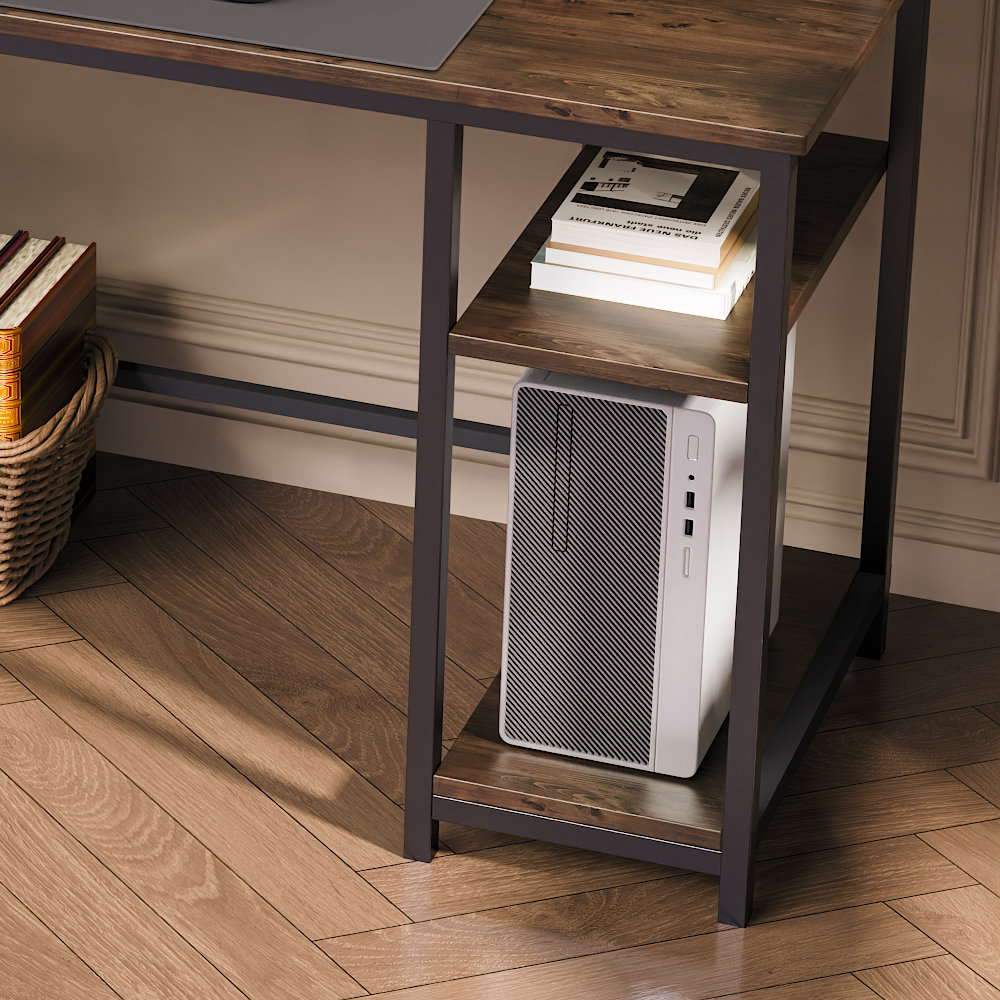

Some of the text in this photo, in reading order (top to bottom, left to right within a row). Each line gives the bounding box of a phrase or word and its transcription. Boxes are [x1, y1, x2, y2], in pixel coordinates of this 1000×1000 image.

[569, 216, 637, 231] FRANKFURT
[627, 220, 653, 228] stadt
[640, 227, 672, 236] NEUE
